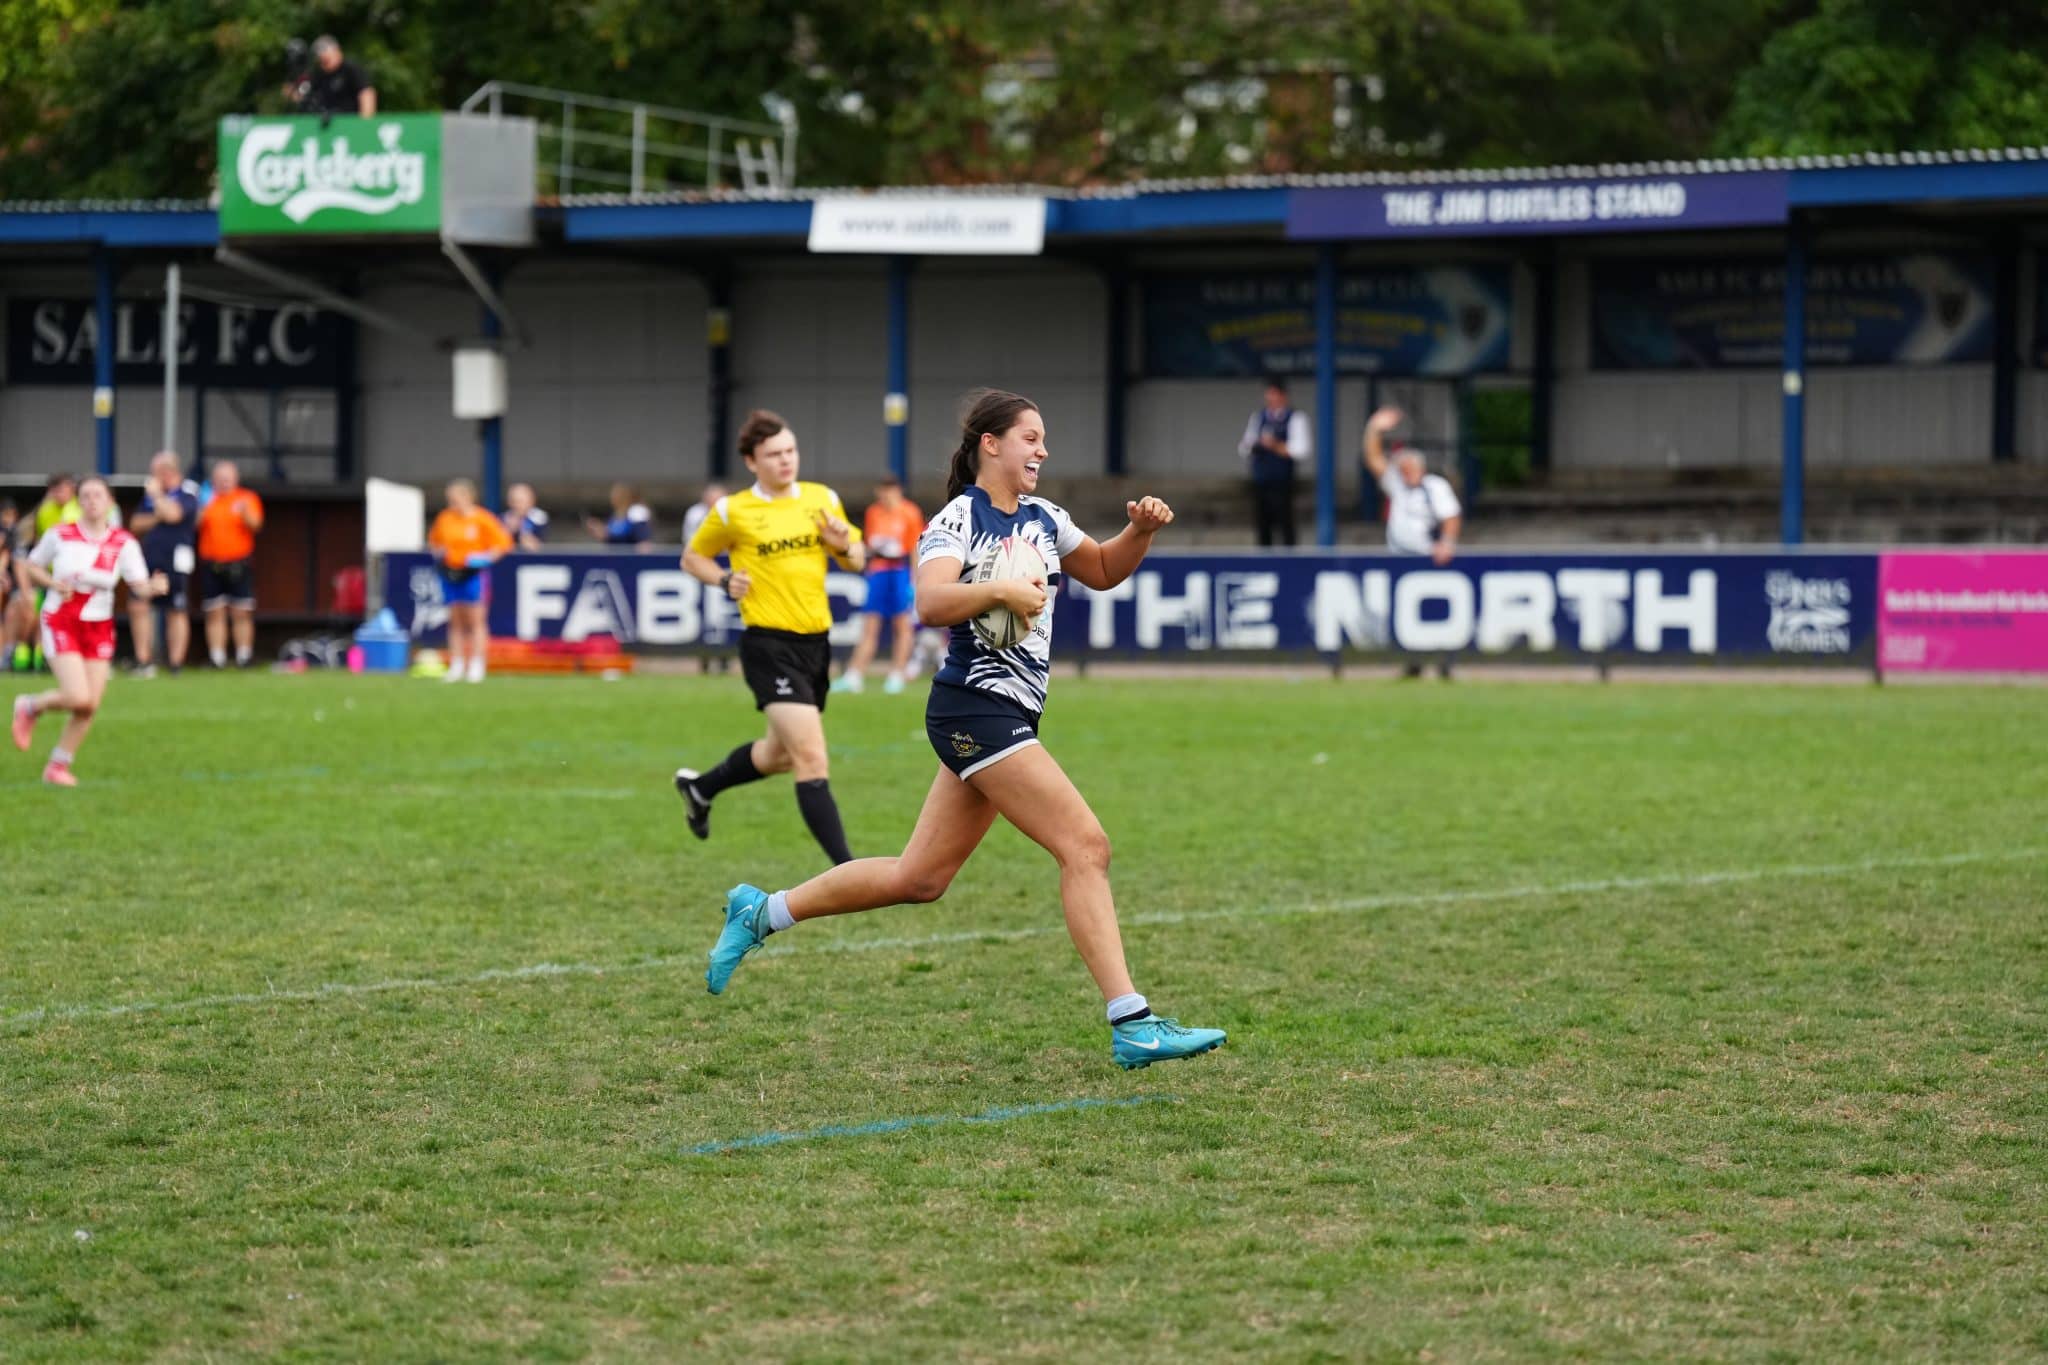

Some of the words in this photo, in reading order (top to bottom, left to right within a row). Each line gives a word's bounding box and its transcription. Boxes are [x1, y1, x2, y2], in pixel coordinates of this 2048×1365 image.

[237, 123, 425, 205] Carlsberg
[1385, 191, 1433, 225] THE
[1436, 189, 1486, 224] JIM
[1488, 186, 1592, 223] BIRTLES
[1594, 182, 1687, 219] STAND
[32, 302, 197, 364] SALE
[216, 302, 318, 365] F.C
[979, 545, 1002, 583] STEE
[515, 565, 868, 646] FABRC
[1068, 570, 1279, 650] THE
[1313, 570, 1718, 652] NORTH
